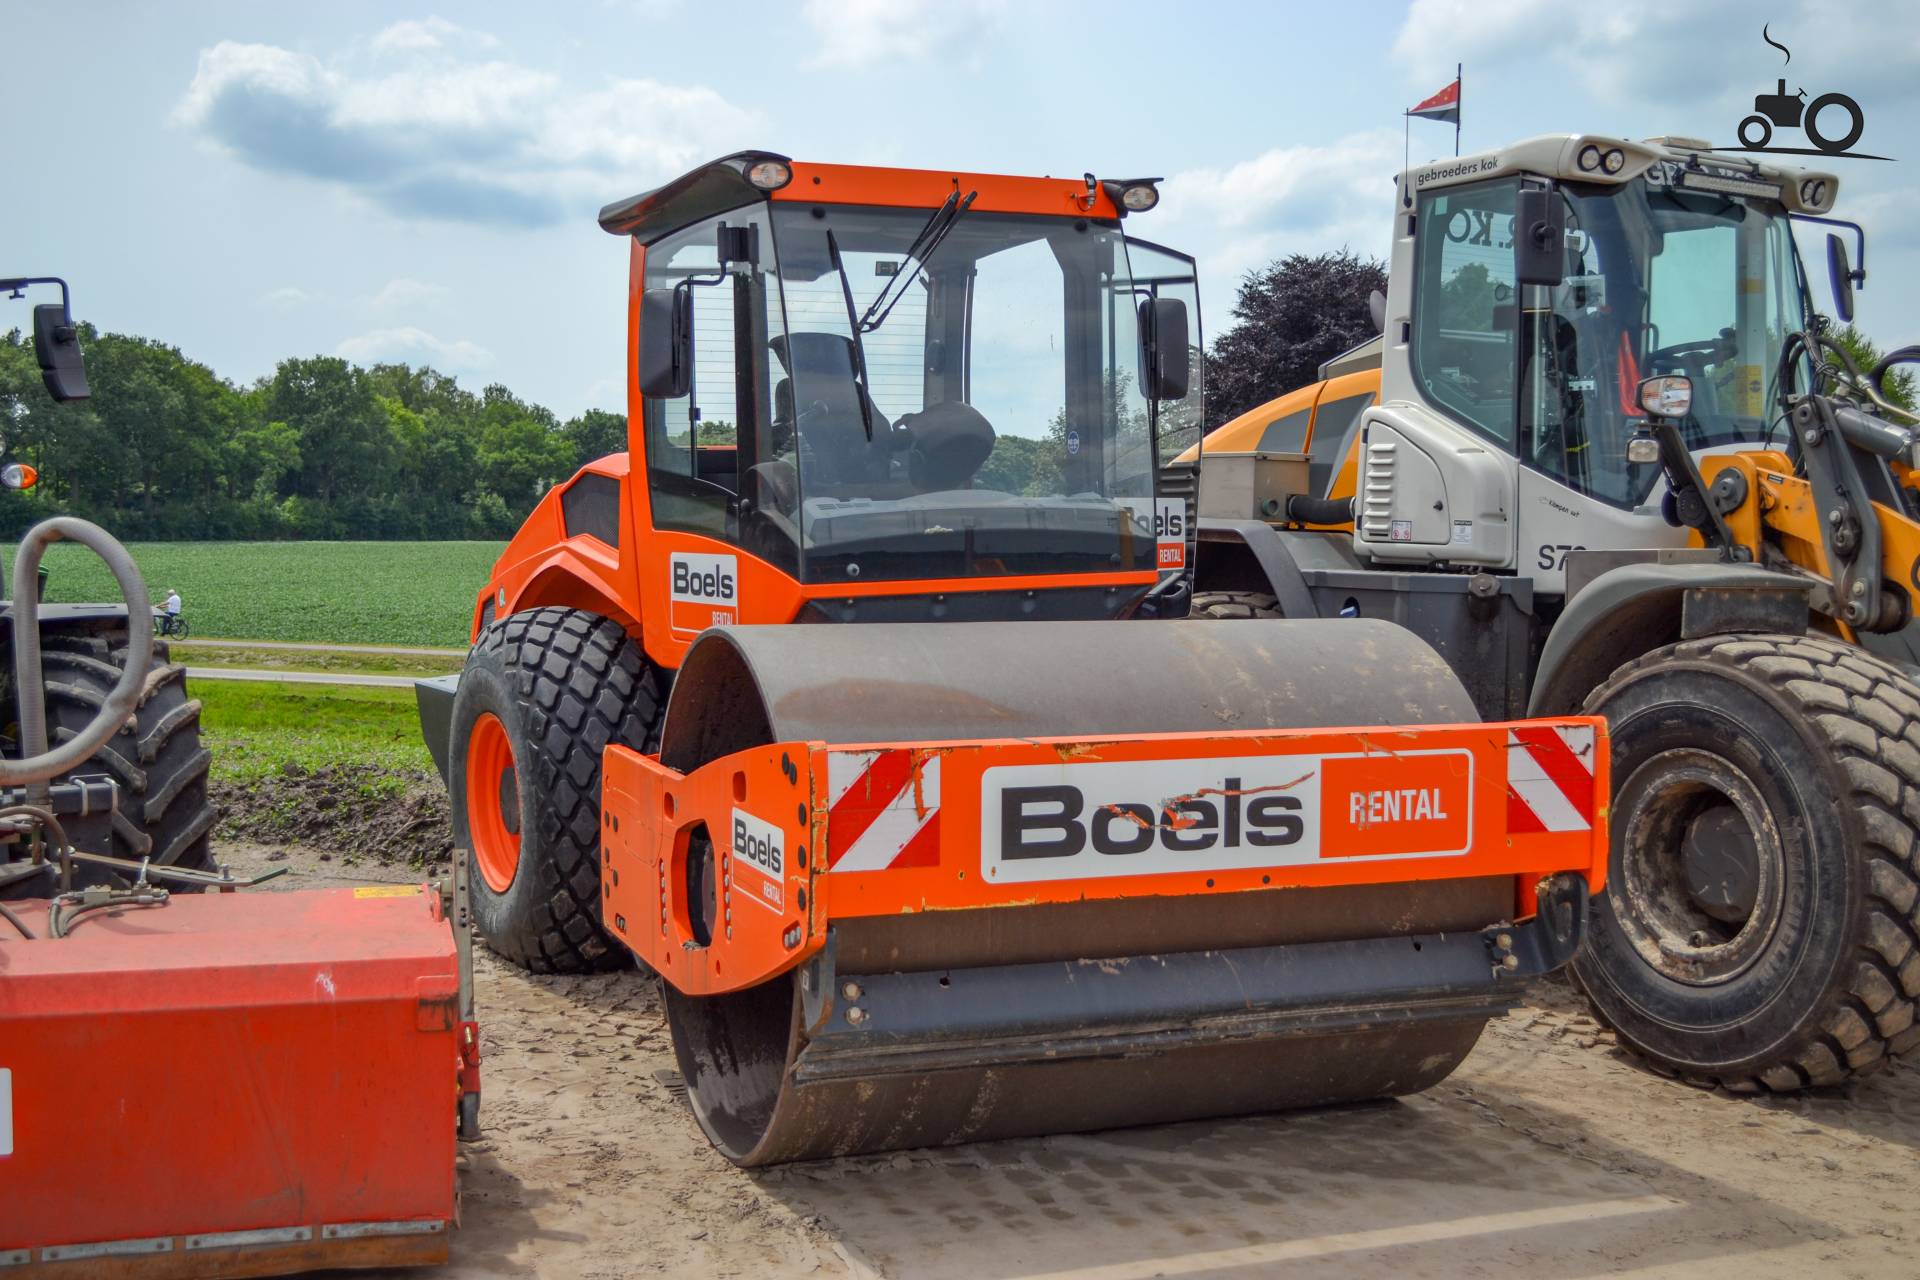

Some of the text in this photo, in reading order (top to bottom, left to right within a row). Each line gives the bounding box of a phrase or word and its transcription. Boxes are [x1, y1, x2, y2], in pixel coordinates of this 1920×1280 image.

[1418, 156, 1498, 186] gebroeders kok
[1160, 549, 1182, 563] RENTAL
[1537, 544, 1587, 571] S7
[673, 561, 734, 599] Boels
[1001, 777, 1447, 861] Boels RENTAL
[734, 817, 781, 874] Boels
[763, 880, 781, 904] RENTAL
